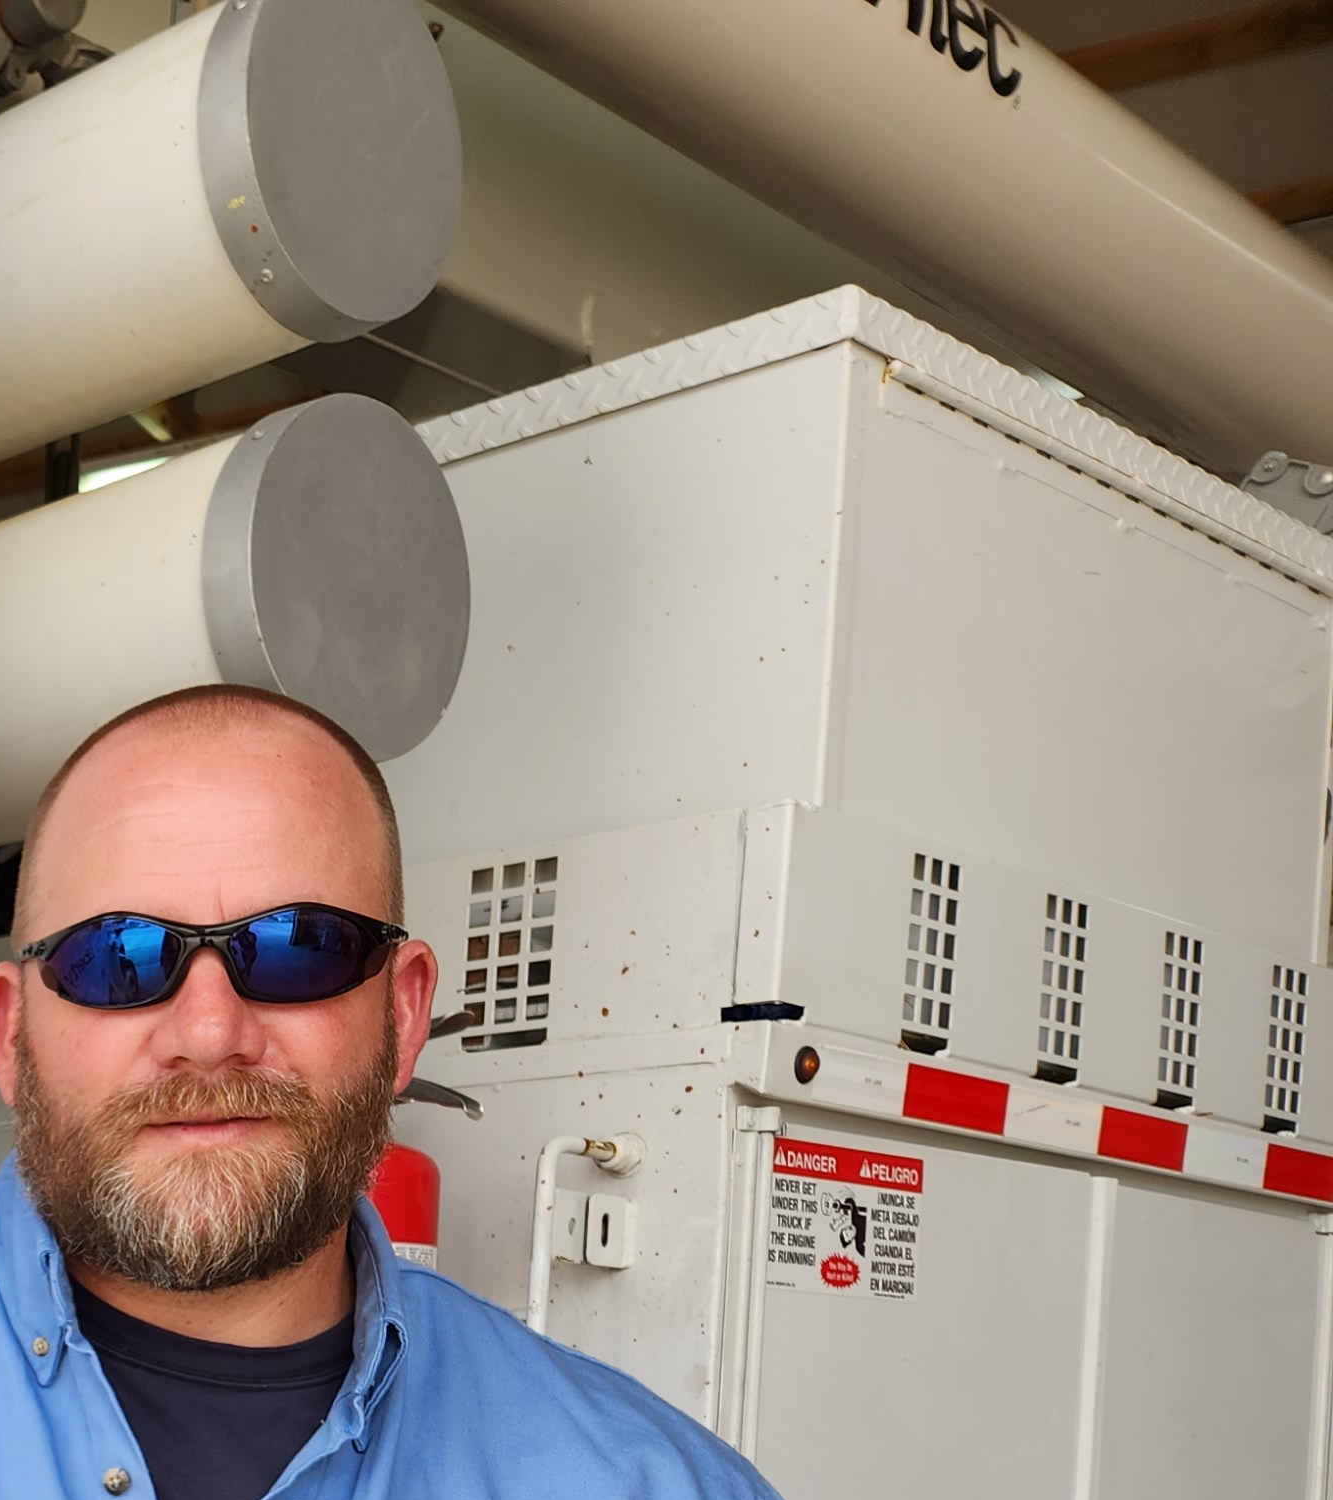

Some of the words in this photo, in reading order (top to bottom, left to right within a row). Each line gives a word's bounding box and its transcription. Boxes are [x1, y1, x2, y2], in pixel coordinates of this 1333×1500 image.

[787, 1151, 837, 1173] DANGER
[872, 1164, 918, 1186] PELIGRO
[775, 1178, 800, 1193] NEVER
[802, 1182, 817, 1195] GET
[772, 1195, 799, 1212] UNDER
[801, 1199, 818, 1214] THIS
[906, 1196, 915, 1210] SE
[777, 1214, 803, 1229] TRUCK
[804, 1218, 812, 1231] IF
[871, 1209, 890, 1223] META
[892, 1211, 919, 1227] DEBAJO
[771, 1231, 786, 1245] THE
[787, 1233, 815, 1249] ENGINE
[873, 1226, 886, 1241] DEL
[768, 1249, 776, 1262] IS
[778, 1251, 816, 1267] RUNNING!
[905, 1248, 913, 1260] EL
[871, 1261, 896, 1277] MOTOR
[870, 1278, 880, 1291] EN
[881, 1280, 914, 1295] MARCHA!
